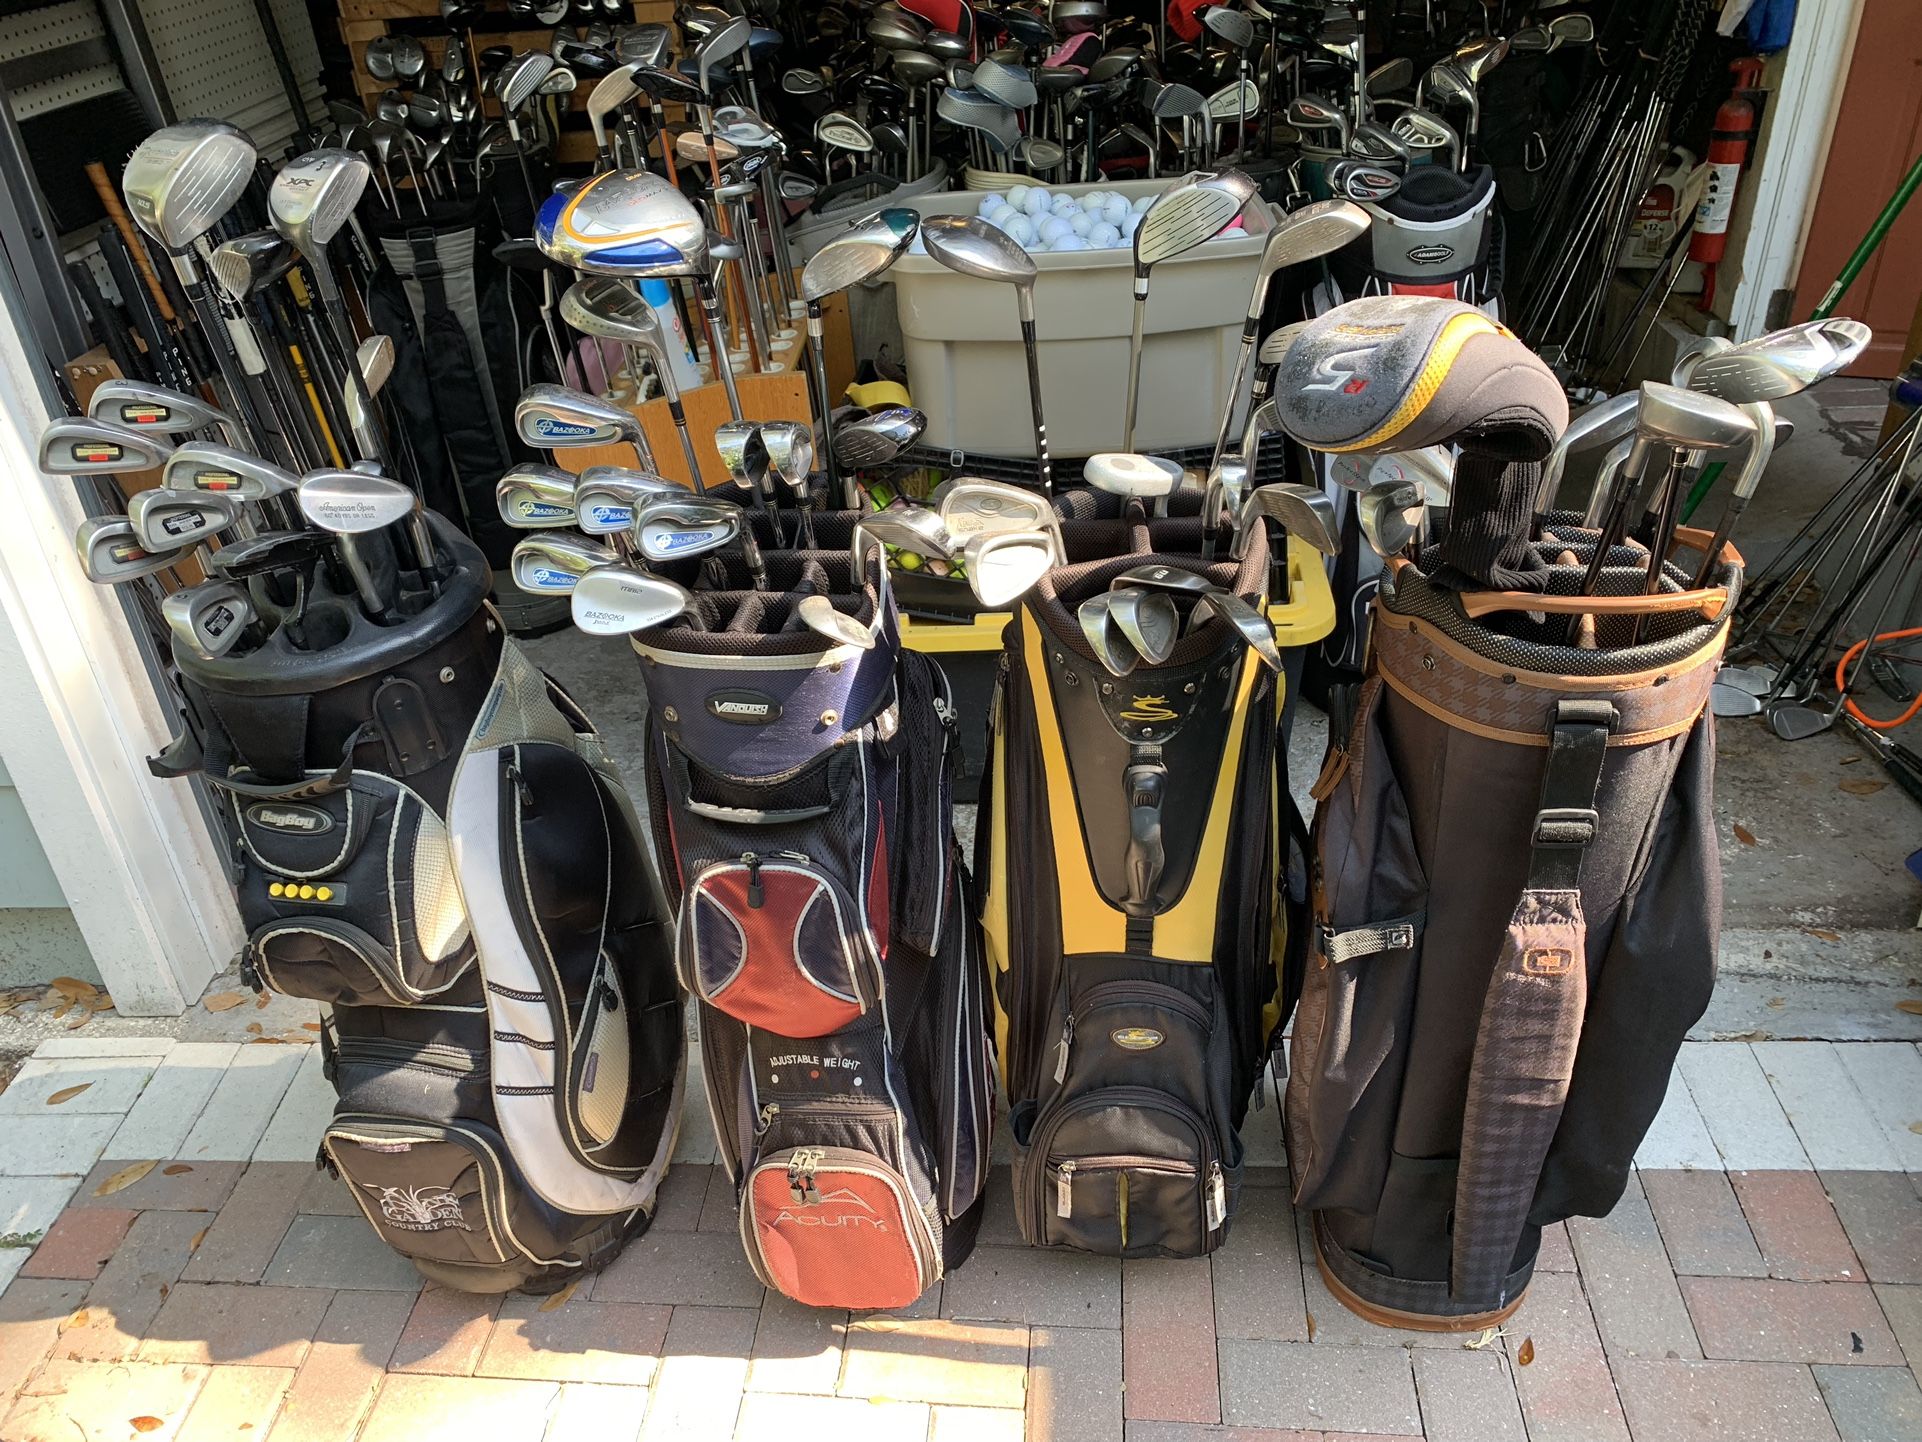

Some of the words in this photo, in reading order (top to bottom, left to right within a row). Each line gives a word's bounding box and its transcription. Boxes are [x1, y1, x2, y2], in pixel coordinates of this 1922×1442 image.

[172, 347, 192, 386] PING
[552, 426, 591, 434] BAZOOKA
[584, 610, 625, 622] BAZOOKA
[714, 700, 769, 715] VANQUISH
[260, 810, 317, 830] BagBoy
[770, 1055, 820, 1068] ADJUSTABLE
[823, 1057, 861, 1071] WEIGHT
[384, 1219, 439, 1232] COUNTRY
[444, 1220, 473, 1232] CLUB
[773, 1210, 885, 1229] ACUITY
